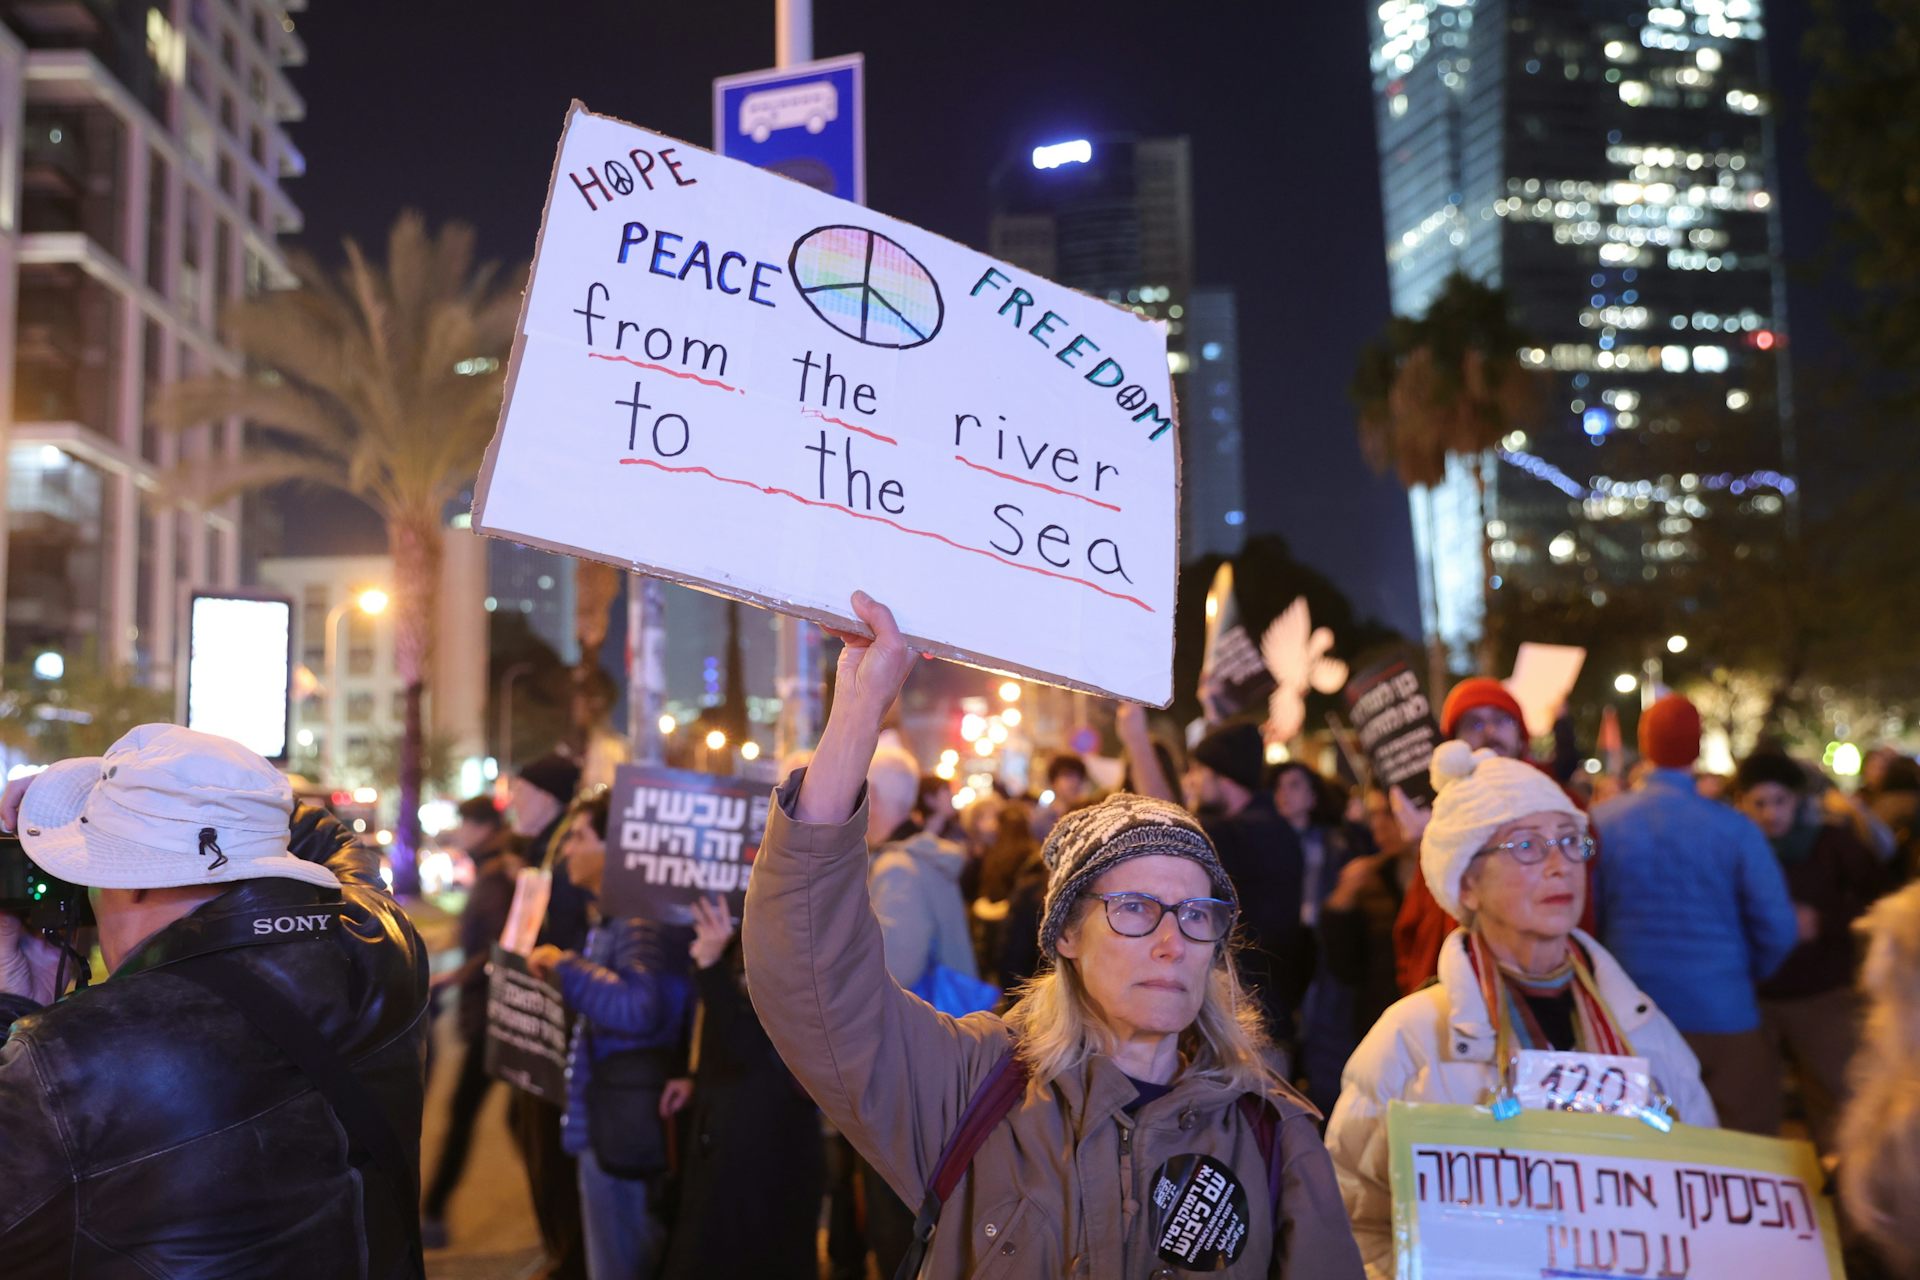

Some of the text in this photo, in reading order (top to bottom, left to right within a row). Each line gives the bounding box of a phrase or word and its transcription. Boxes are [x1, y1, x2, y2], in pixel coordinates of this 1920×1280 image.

[569, 148, 697, 211] HOPE
[617, 222, 782, 308] PEACE
[969, 267, 1173, 442] FREEDOM
[573, 283, 1120, 492] from the river
[615, 381, 689, 457] to
[805, 430, 905, 515] the
[621, 821, 743, 861] זה היום
[624, 852, 739, 892] שאחרי
[253, 914, 331, 935] SONY
[1196, 1164, 1213, 1186] אין
[1417, 1148, 1585, 1213] המלחמה
[1595, 1168, 1658, 1208] את
[1160, 1184, 1202, 1250] דמוקרטיה
[1172, 1172, 1227, 1257] עם כיבוש
[1187, 1227, 1210, 1263] DEMOCRACY
[1206, 1215, 1218, 1229] AND
[1546, 1224, 1690, 1279] עכשיו
